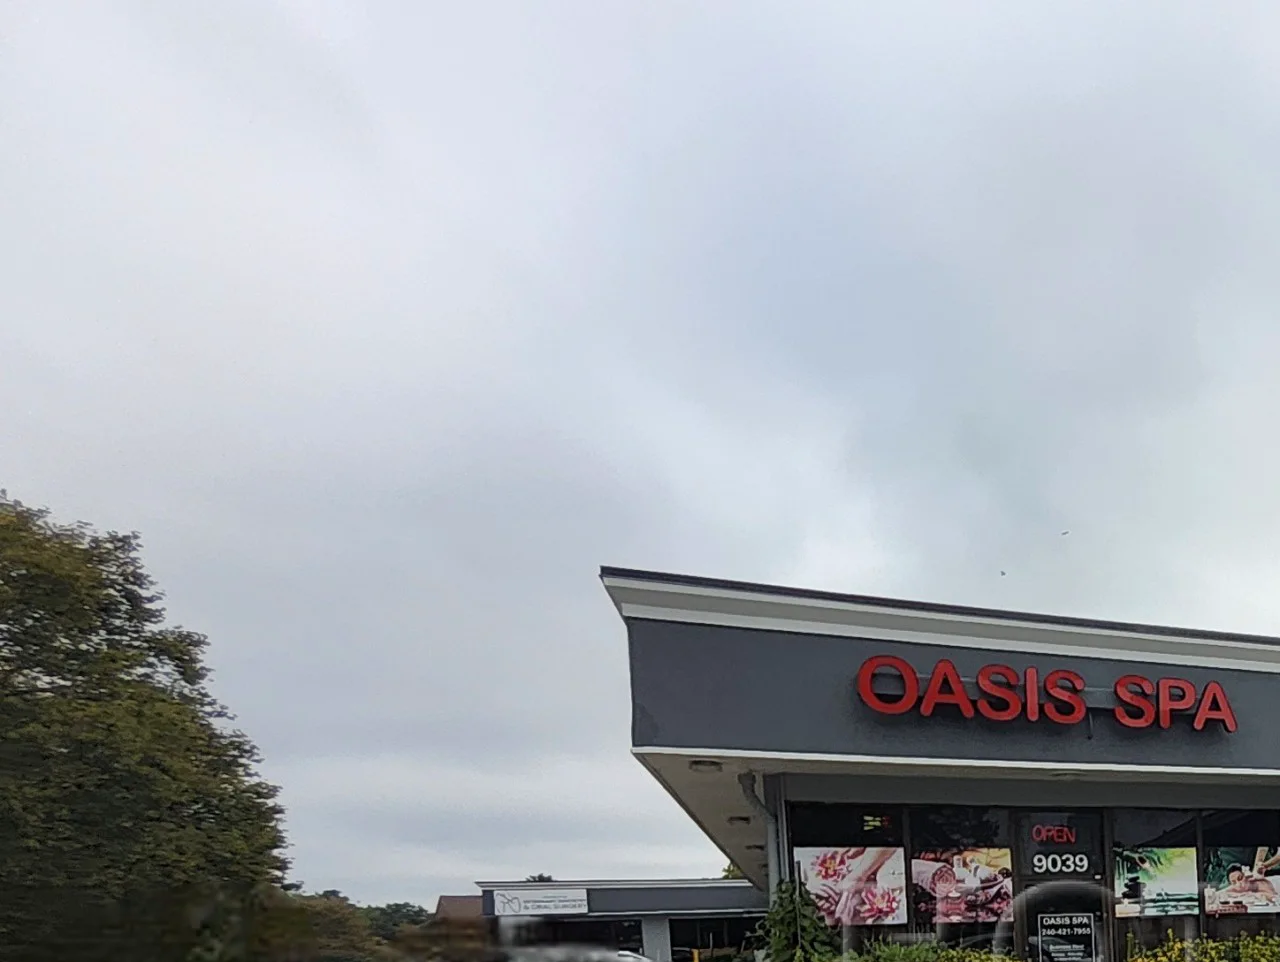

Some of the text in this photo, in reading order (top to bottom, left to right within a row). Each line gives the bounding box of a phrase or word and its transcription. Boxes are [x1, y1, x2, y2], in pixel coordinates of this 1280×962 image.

[856, 655, 1238, 733] OASIS SPA
[1032, 824, 1076, 844] OPEN
[1033, 854, 1089, 873] 9039
[1042, 916, 1089, 925] OASIS SPA
